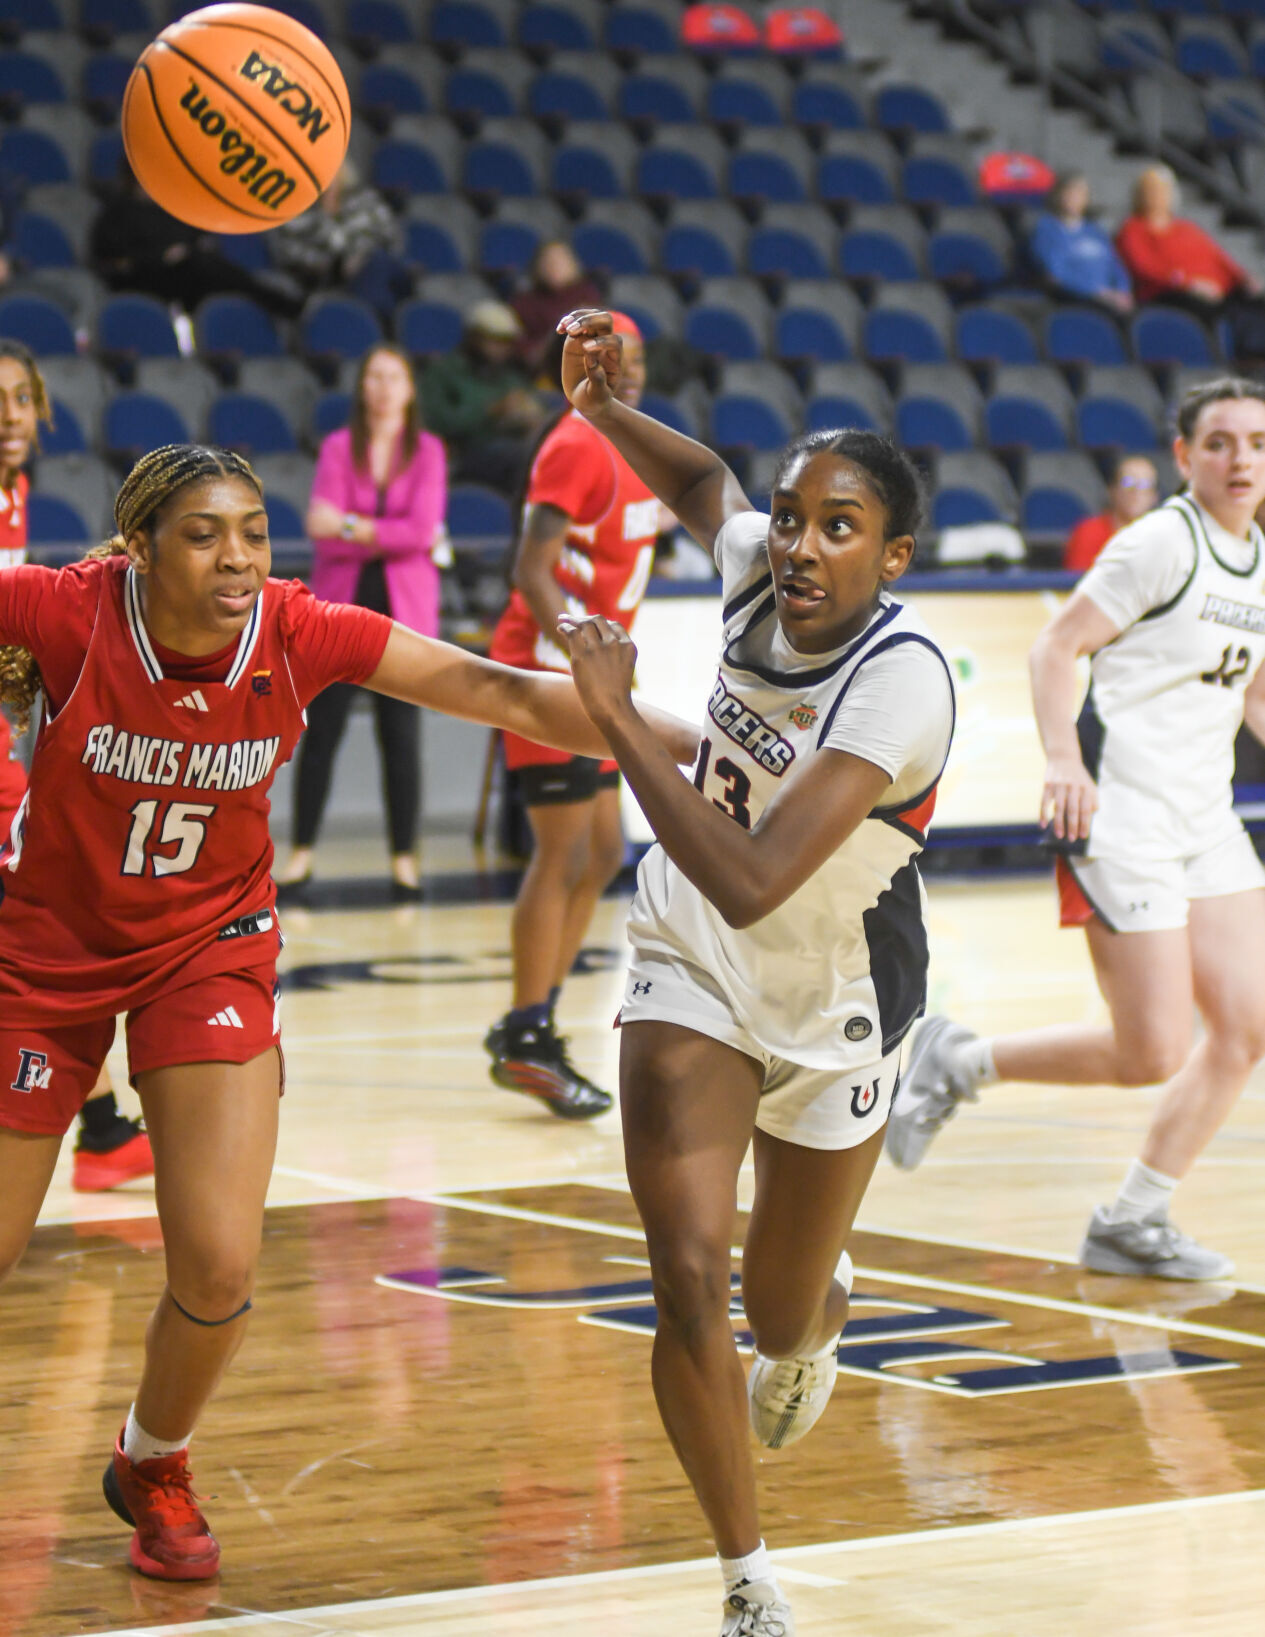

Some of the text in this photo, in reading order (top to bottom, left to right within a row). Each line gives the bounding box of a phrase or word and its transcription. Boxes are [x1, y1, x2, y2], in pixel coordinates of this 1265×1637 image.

[240, 49, 331, 143] NCAA
[179, 82, 297, 210] Wilson
[81, 723, 281, 791] FRANCIS MARION
[708, 668, 796, 778] ACERS
[694, 736, 752, 831] 13
[120, 799, 219, 878] 15
